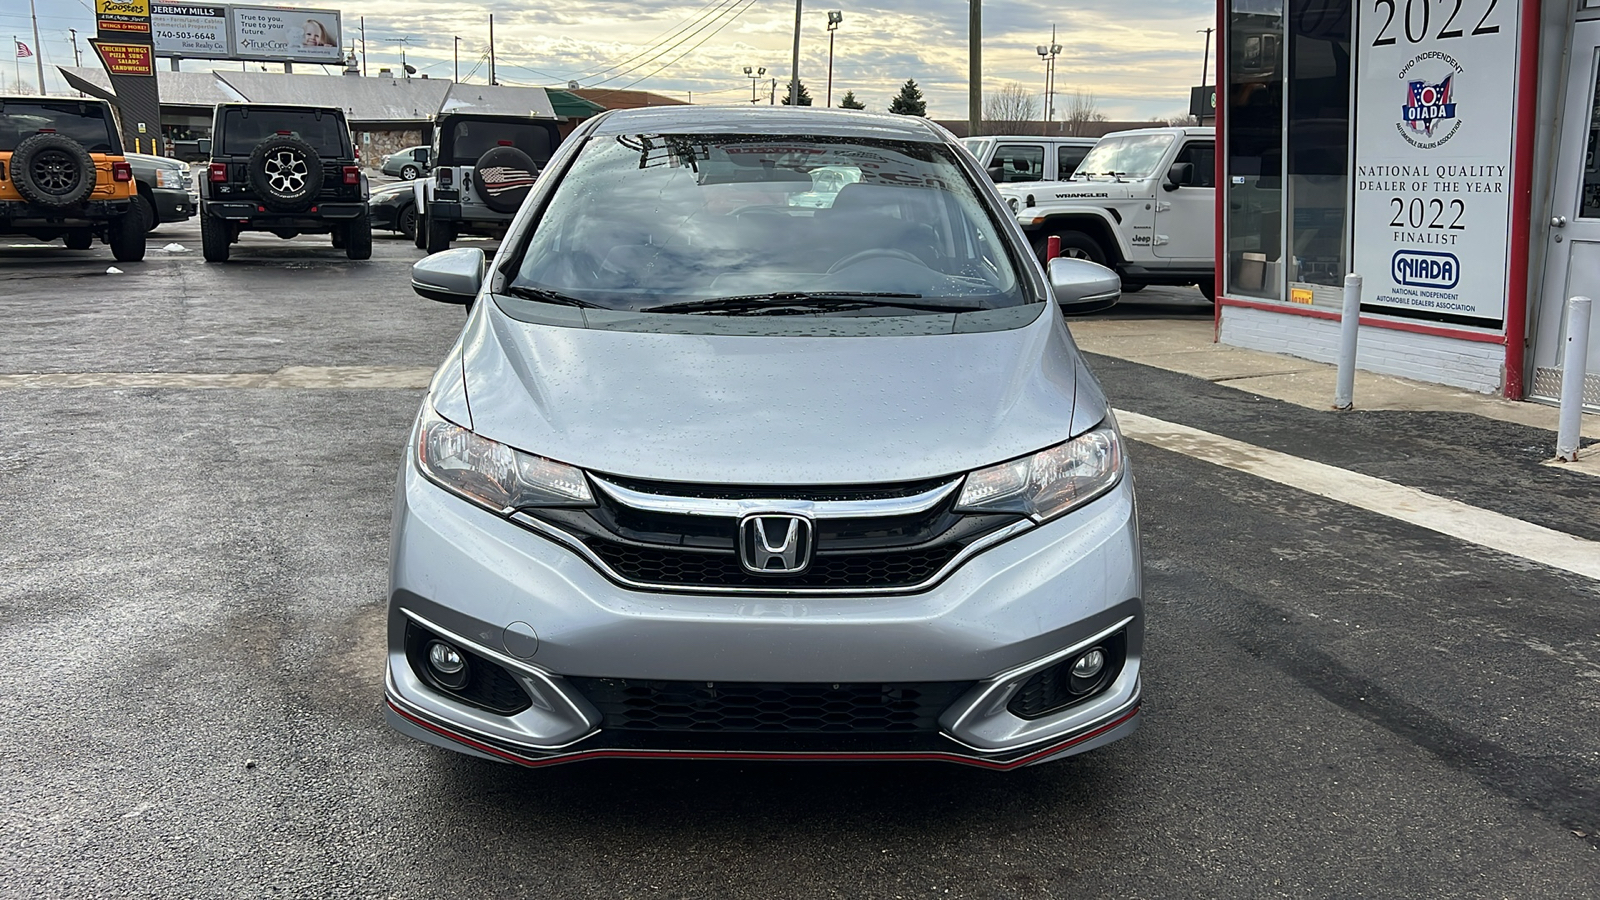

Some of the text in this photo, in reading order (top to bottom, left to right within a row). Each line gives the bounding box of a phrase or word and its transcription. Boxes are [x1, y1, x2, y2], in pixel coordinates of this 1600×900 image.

[101, 1, 144, 13] Roosters
[153, 6, 215, 16] JEREMY MILLS
[1372, 0, 1500, 47] 2022
[156, 31, 216, 40] 740-503-6648
[195, 42, 213, 50] Realty
[1399, 51, 1464, 79] OHIO INDEPENDENT
[1408, 105, 1447, 120] OIADA
[1396, 119, 1462, 149] AUTOMOBILE DEALERS ASSOCIATION
[1358, 166, 1505, 179] NATIONAL QUALITY
[1359, 181, 1502, 193] DEALER OF THE YEAR
[1389, 198, 1466, 230] 2022
[1132, 234, 1151, 243] Jeep
[1393, 232, 1458, 245] FINALIST
[1397, 257, 1453, 284] NIADA
[1392, 288, 1459, 300] NATIONAL INDEPENDENT
[1376, 295, 1476, 312] AUTOMOBILE DEALERS ASSOCIATION
